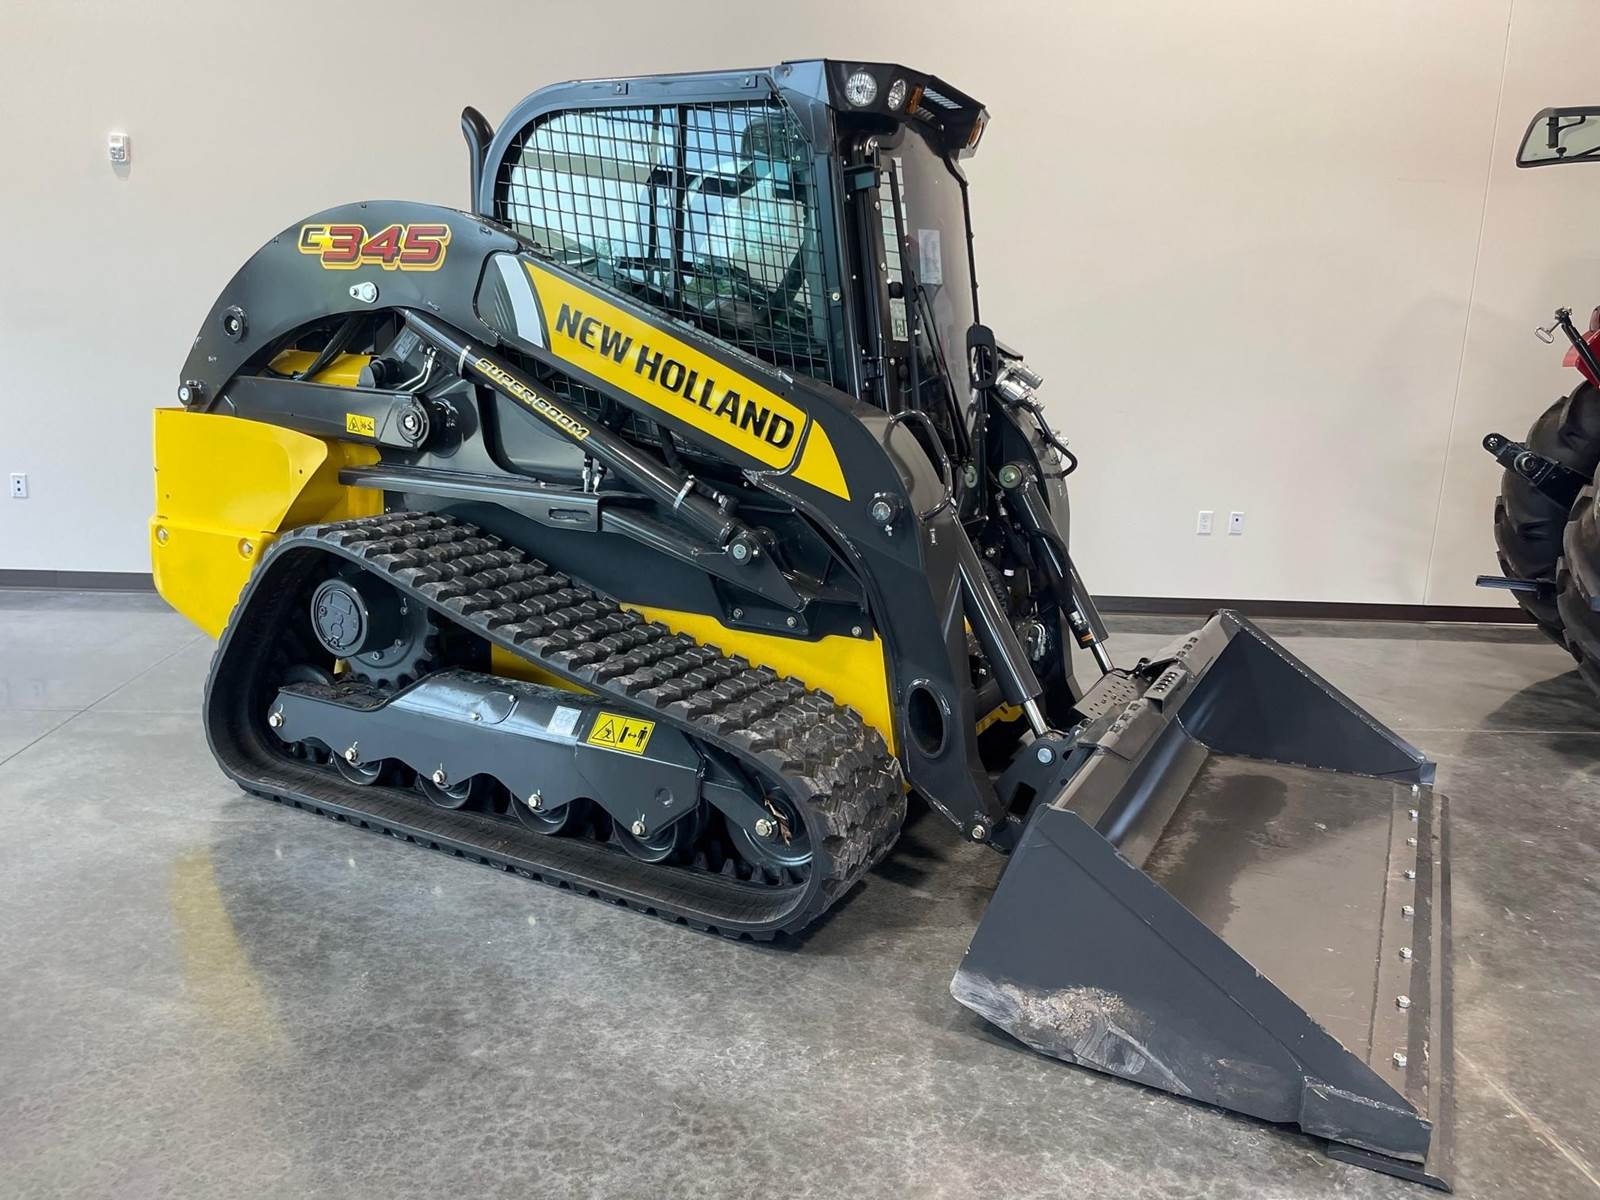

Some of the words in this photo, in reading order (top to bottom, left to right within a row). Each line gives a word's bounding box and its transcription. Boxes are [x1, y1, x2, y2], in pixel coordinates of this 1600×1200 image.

[298, 224, 451, 271] C345
[555, 303, 633, 365] NEW
[634, 344, 795, 449] HOLLAND
